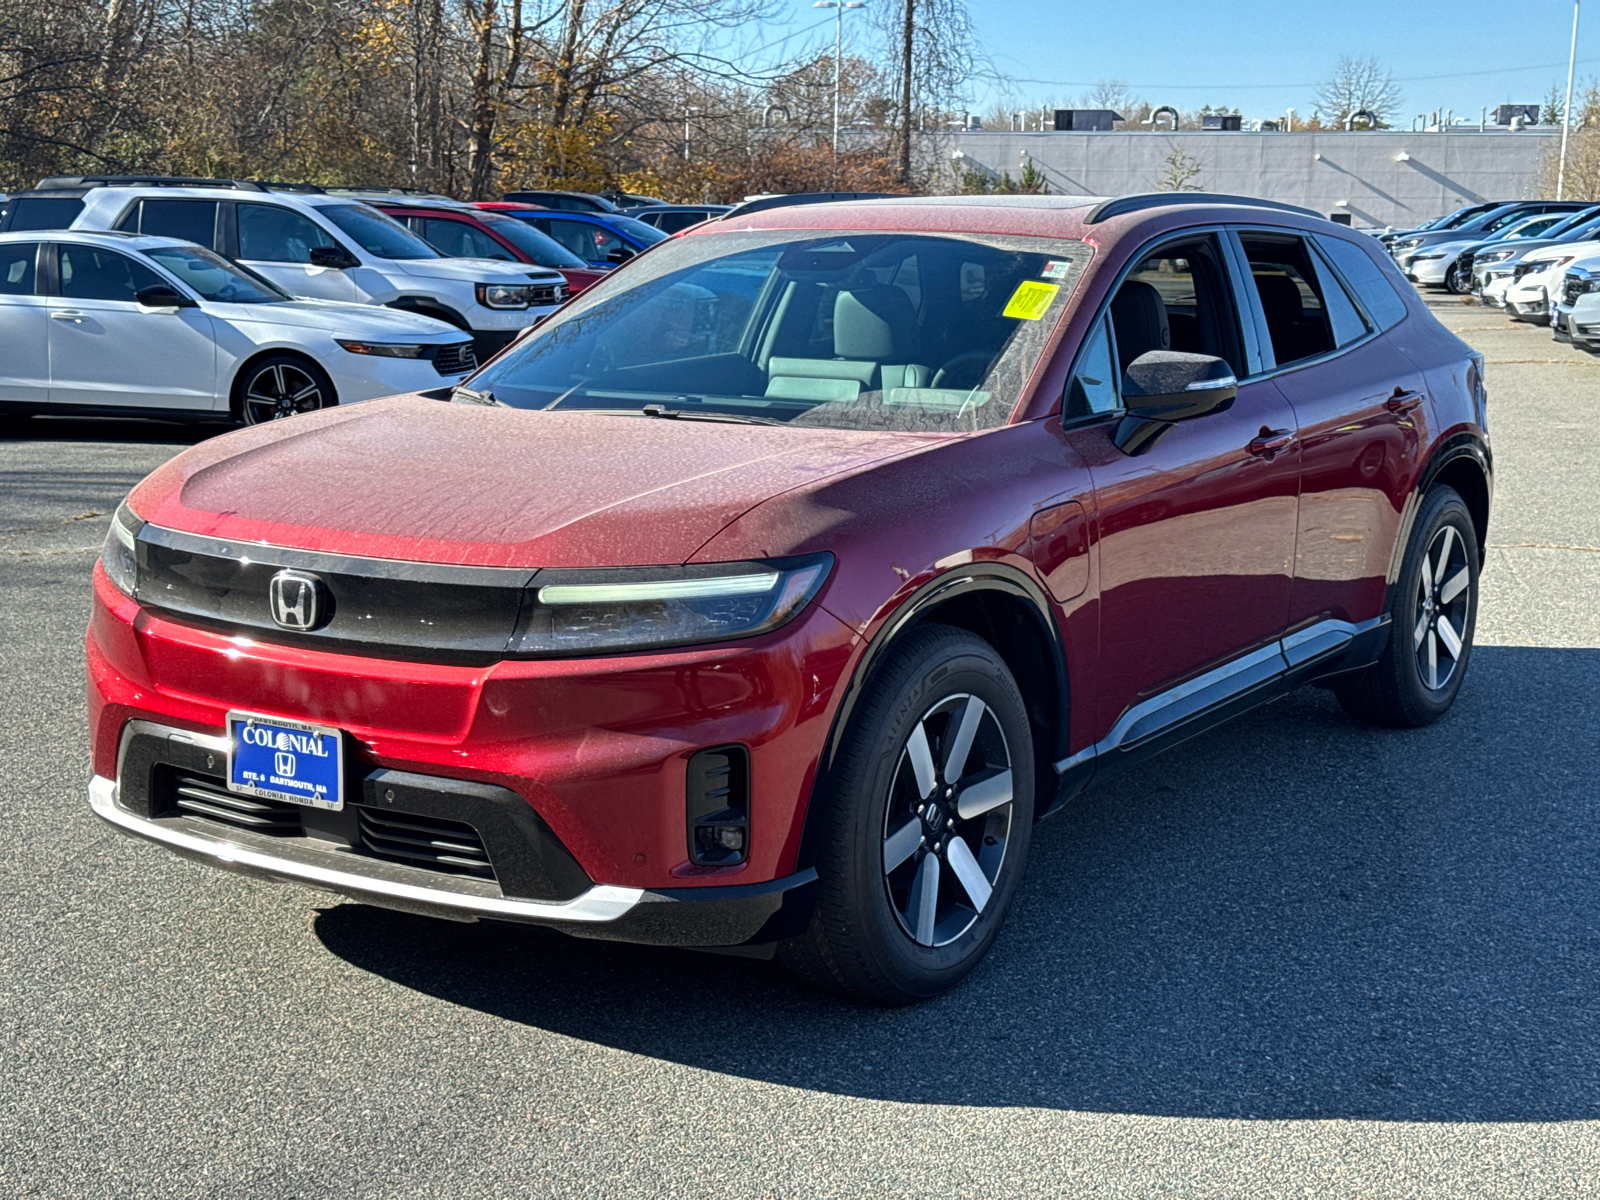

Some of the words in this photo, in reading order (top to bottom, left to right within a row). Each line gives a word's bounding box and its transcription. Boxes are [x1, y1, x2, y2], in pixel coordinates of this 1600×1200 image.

[887, 689, 919, 745] ALENZA
[243, 726, 328, 757] COLONIAL
[242, 771, 259, 781] RTE.
[260, 774, 266, 782] 6
[269, 775, 315, 793] DARTMOUTH,
[315, 784, 328, 794] MA
[254, 788, 288, 801] COLONIAL
[288, 795, 314, 806] HONDA
